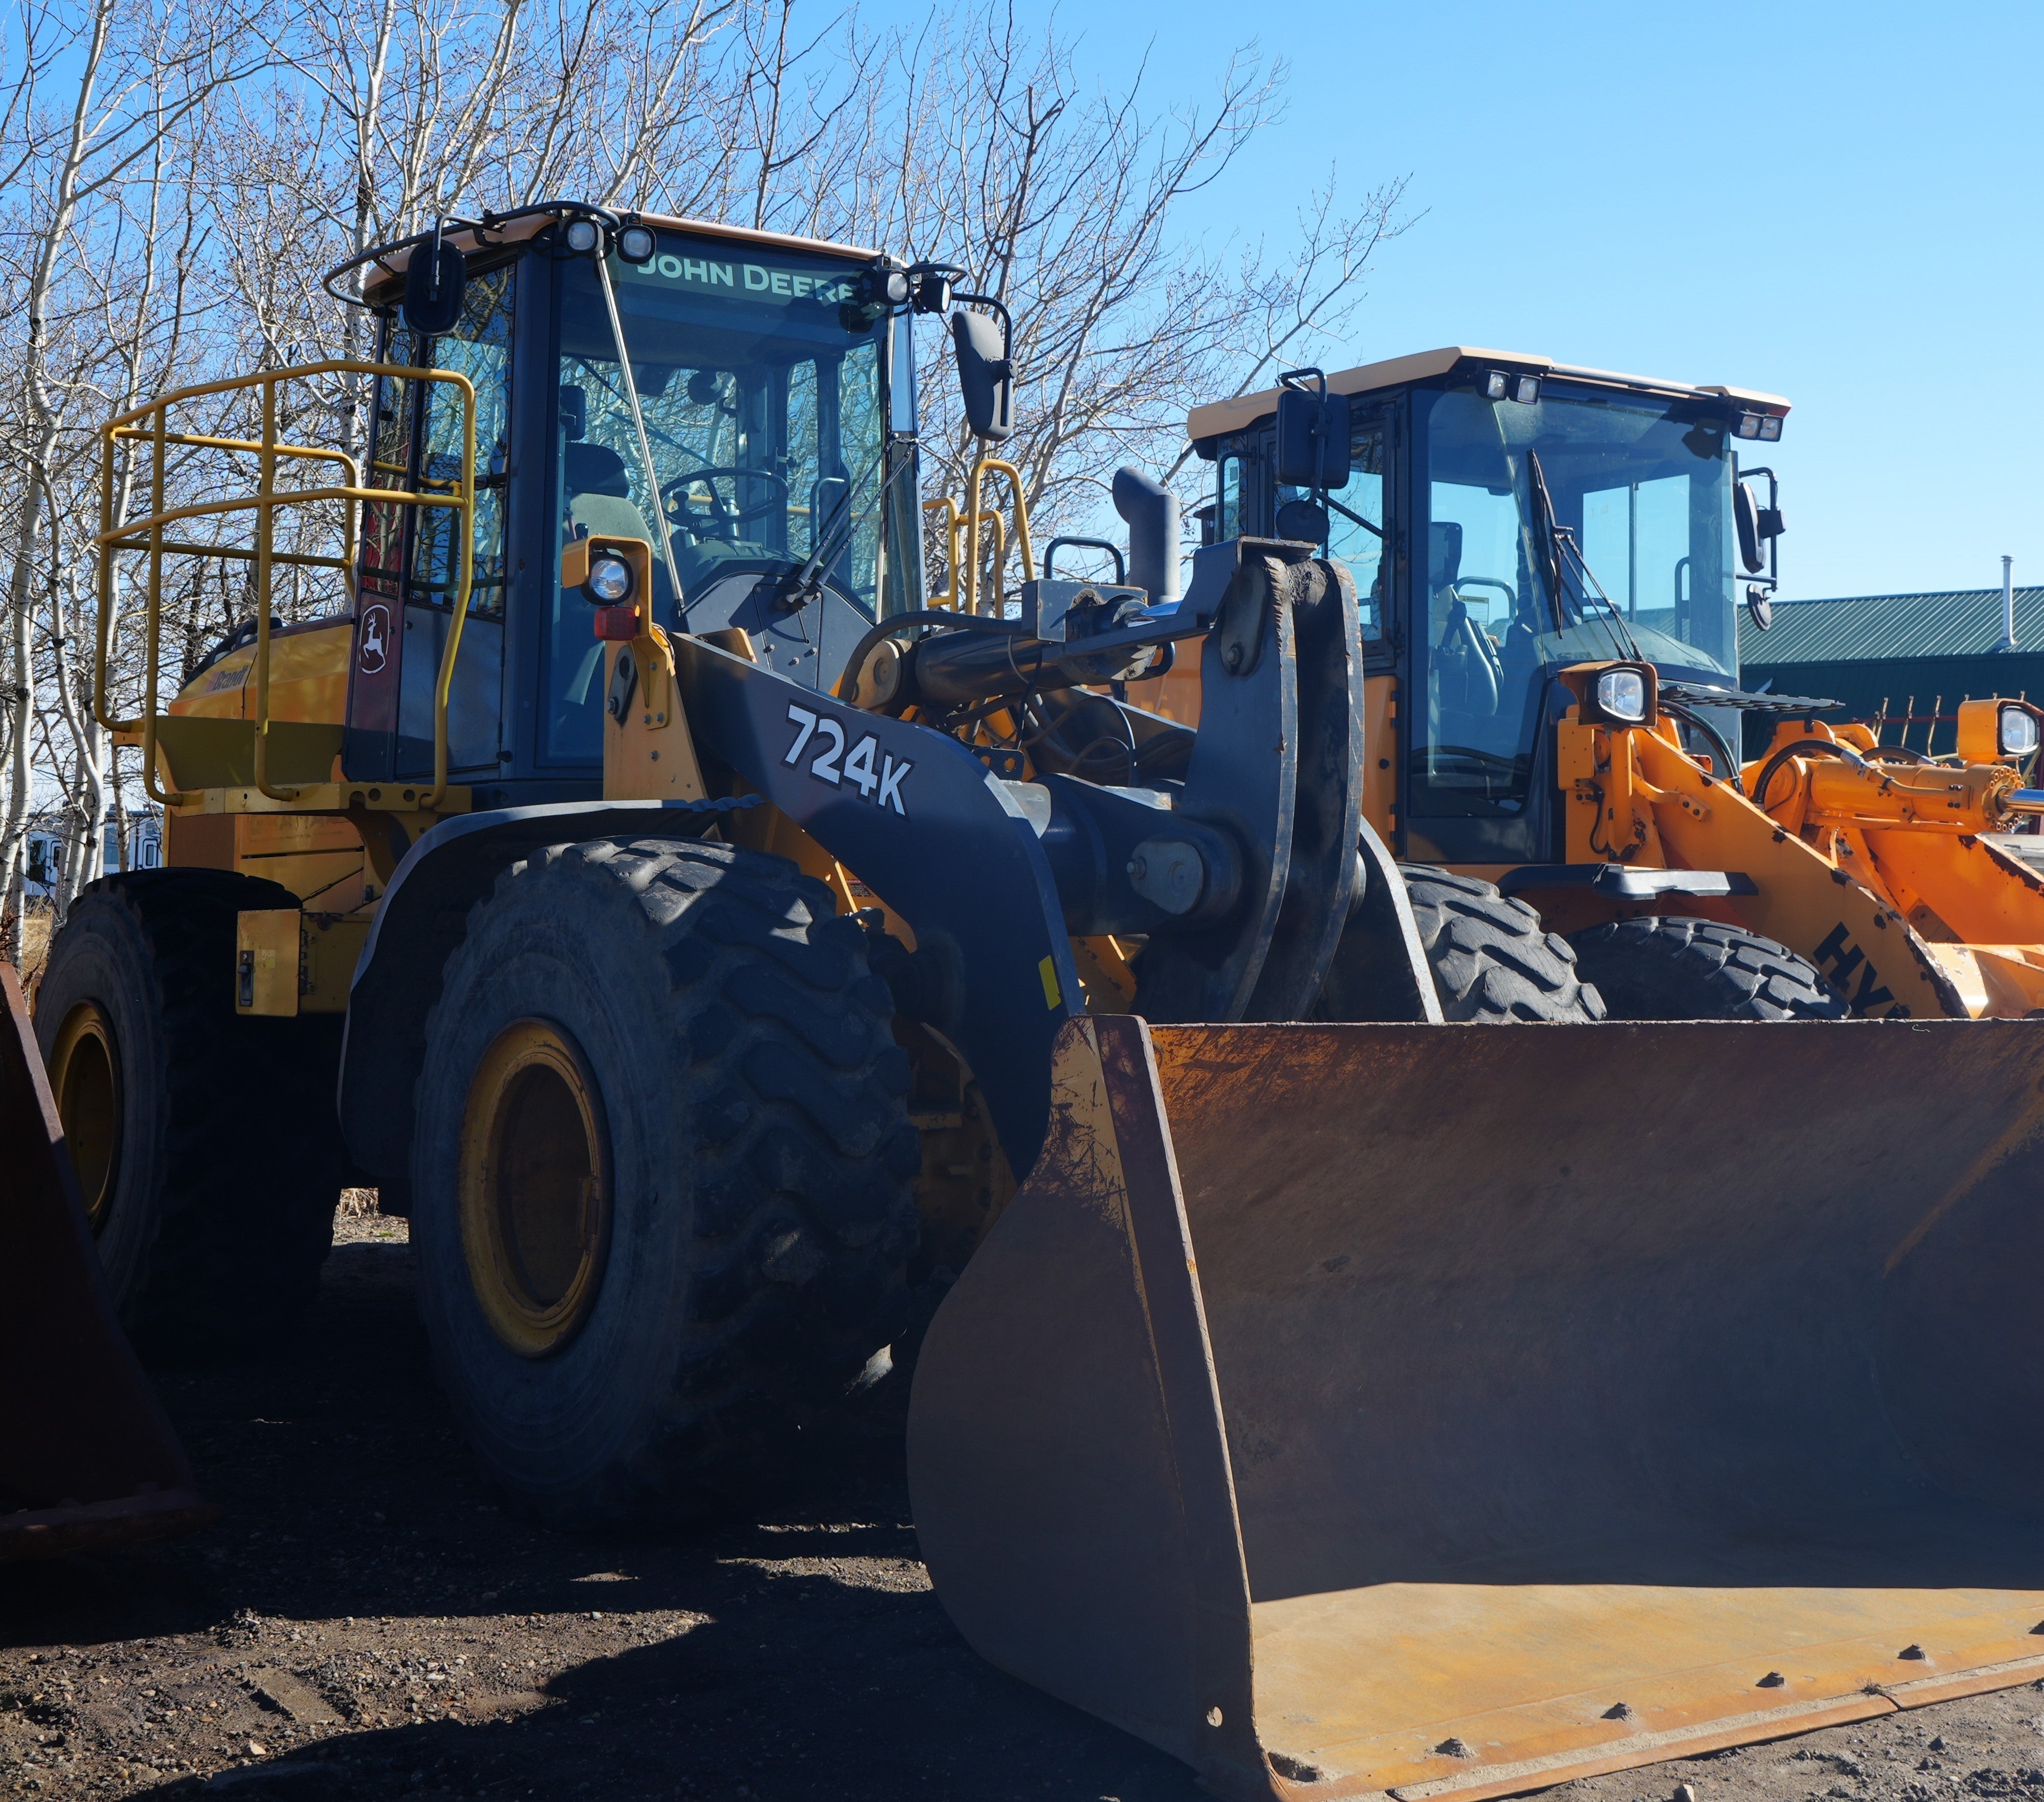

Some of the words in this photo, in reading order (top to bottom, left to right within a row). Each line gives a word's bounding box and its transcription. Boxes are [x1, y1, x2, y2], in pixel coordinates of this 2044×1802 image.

[637, 255, 734, 287] JOHN
[743, 264, 858, 305] DEERE
[211, 665, 249, 691] Brandt
[785, 704, 911, 816] 724K
[1813, 921, 1903, 1018] HY
